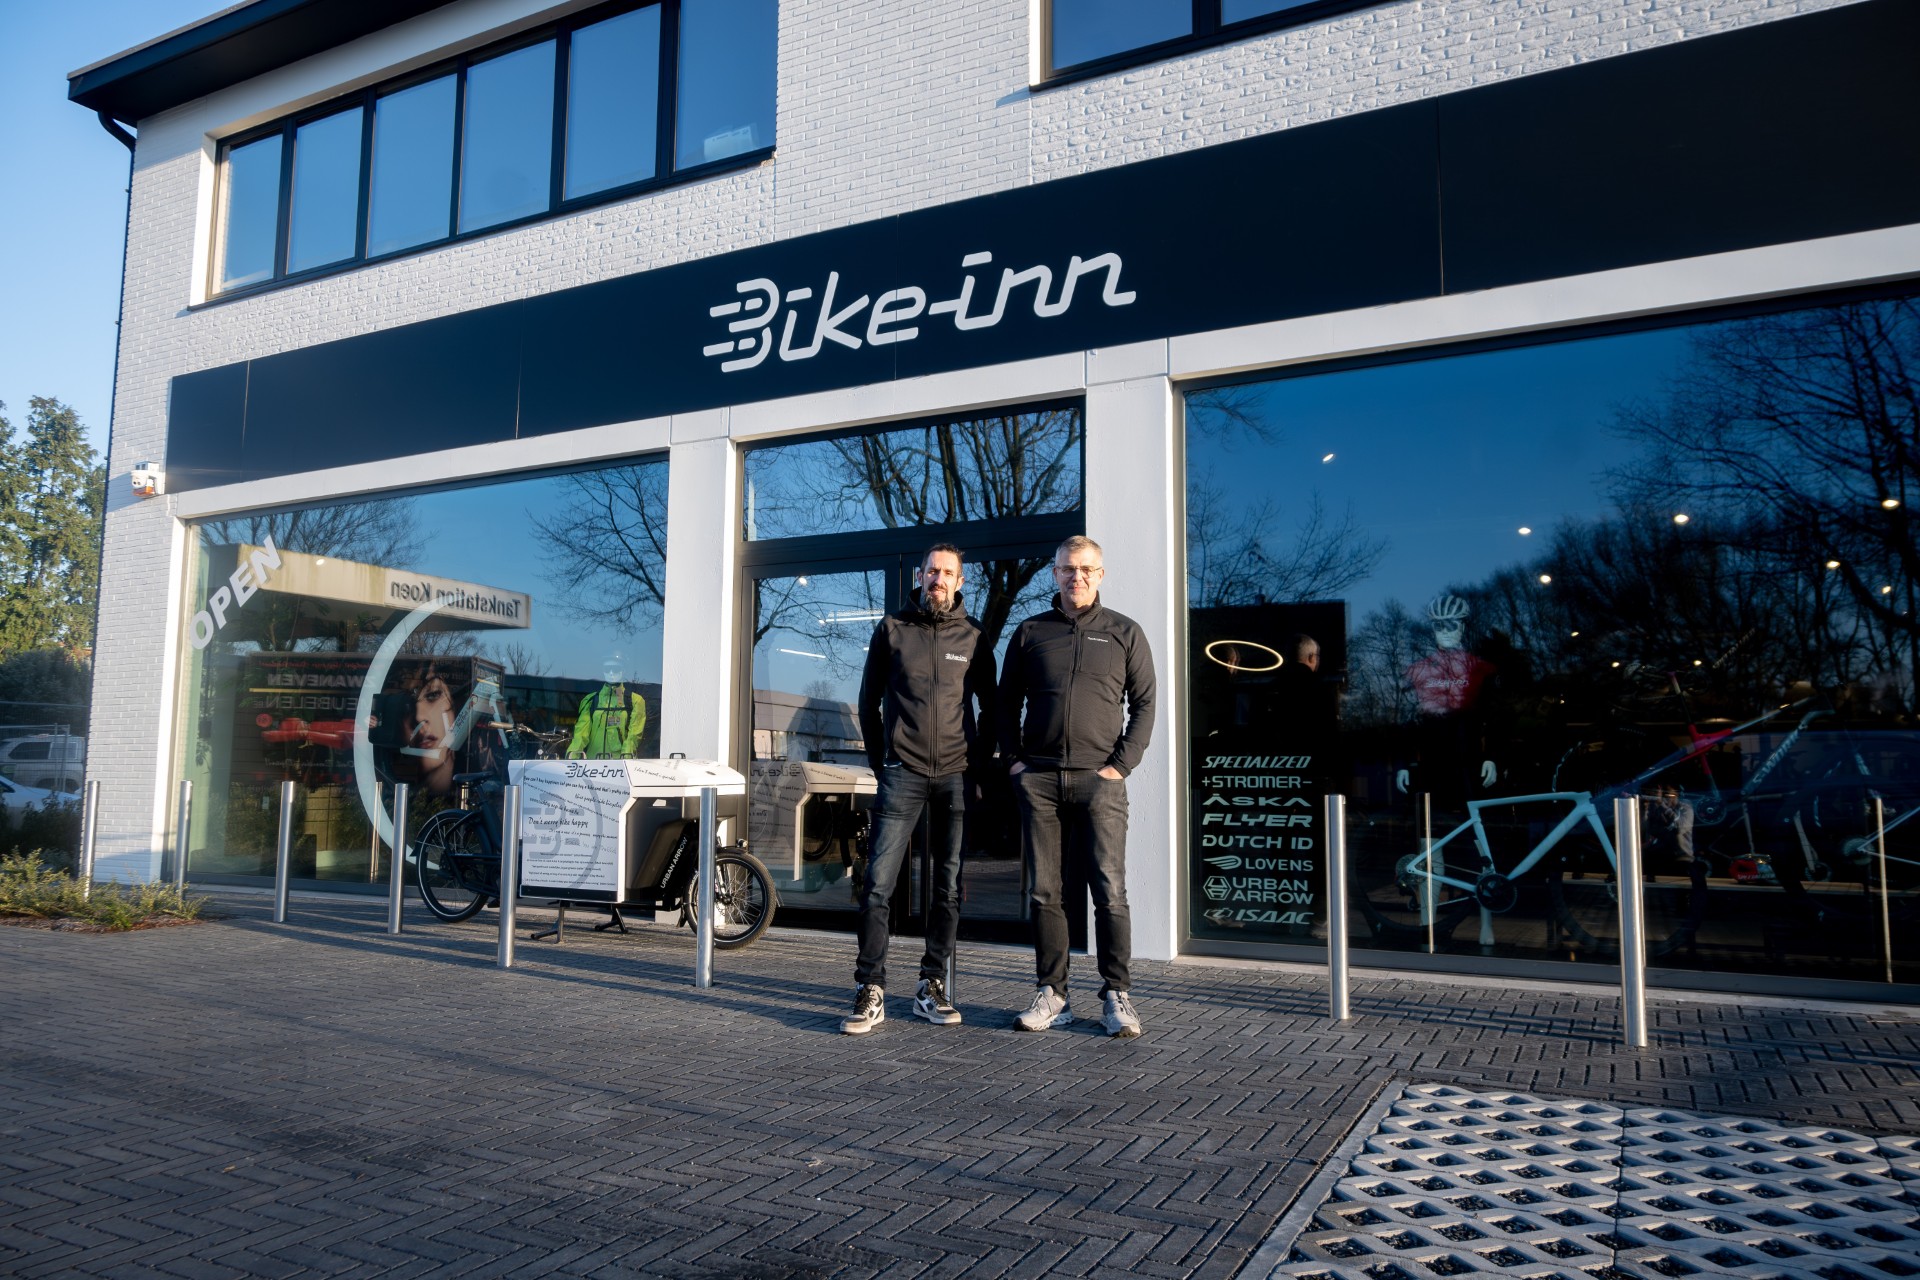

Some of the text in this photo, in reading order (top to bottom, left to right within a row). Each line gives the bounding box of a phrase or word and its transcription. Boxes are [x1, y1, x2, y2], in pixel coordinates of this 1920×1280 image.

[703, 251, 1136, 372] Bike-inn
[190, 534, 281, 649] OPEN
[565, 762, 625, 778] Bike-inn
[1202, 755, 1311, 769] SPECIALIZED
[1202, 813, 1312, 827] FLYER
[1202, 834, 1313, 850] DUTCH ID
[660, 836, 688, 889] URBAN ARROW
[1245, 858, 1314, 872] LOVENS
[1232, 876, 1309, 891] URBAN
[1232, 890, 1314, 905] ARROW
[1235, 908, 1315, 925] ISAAC
